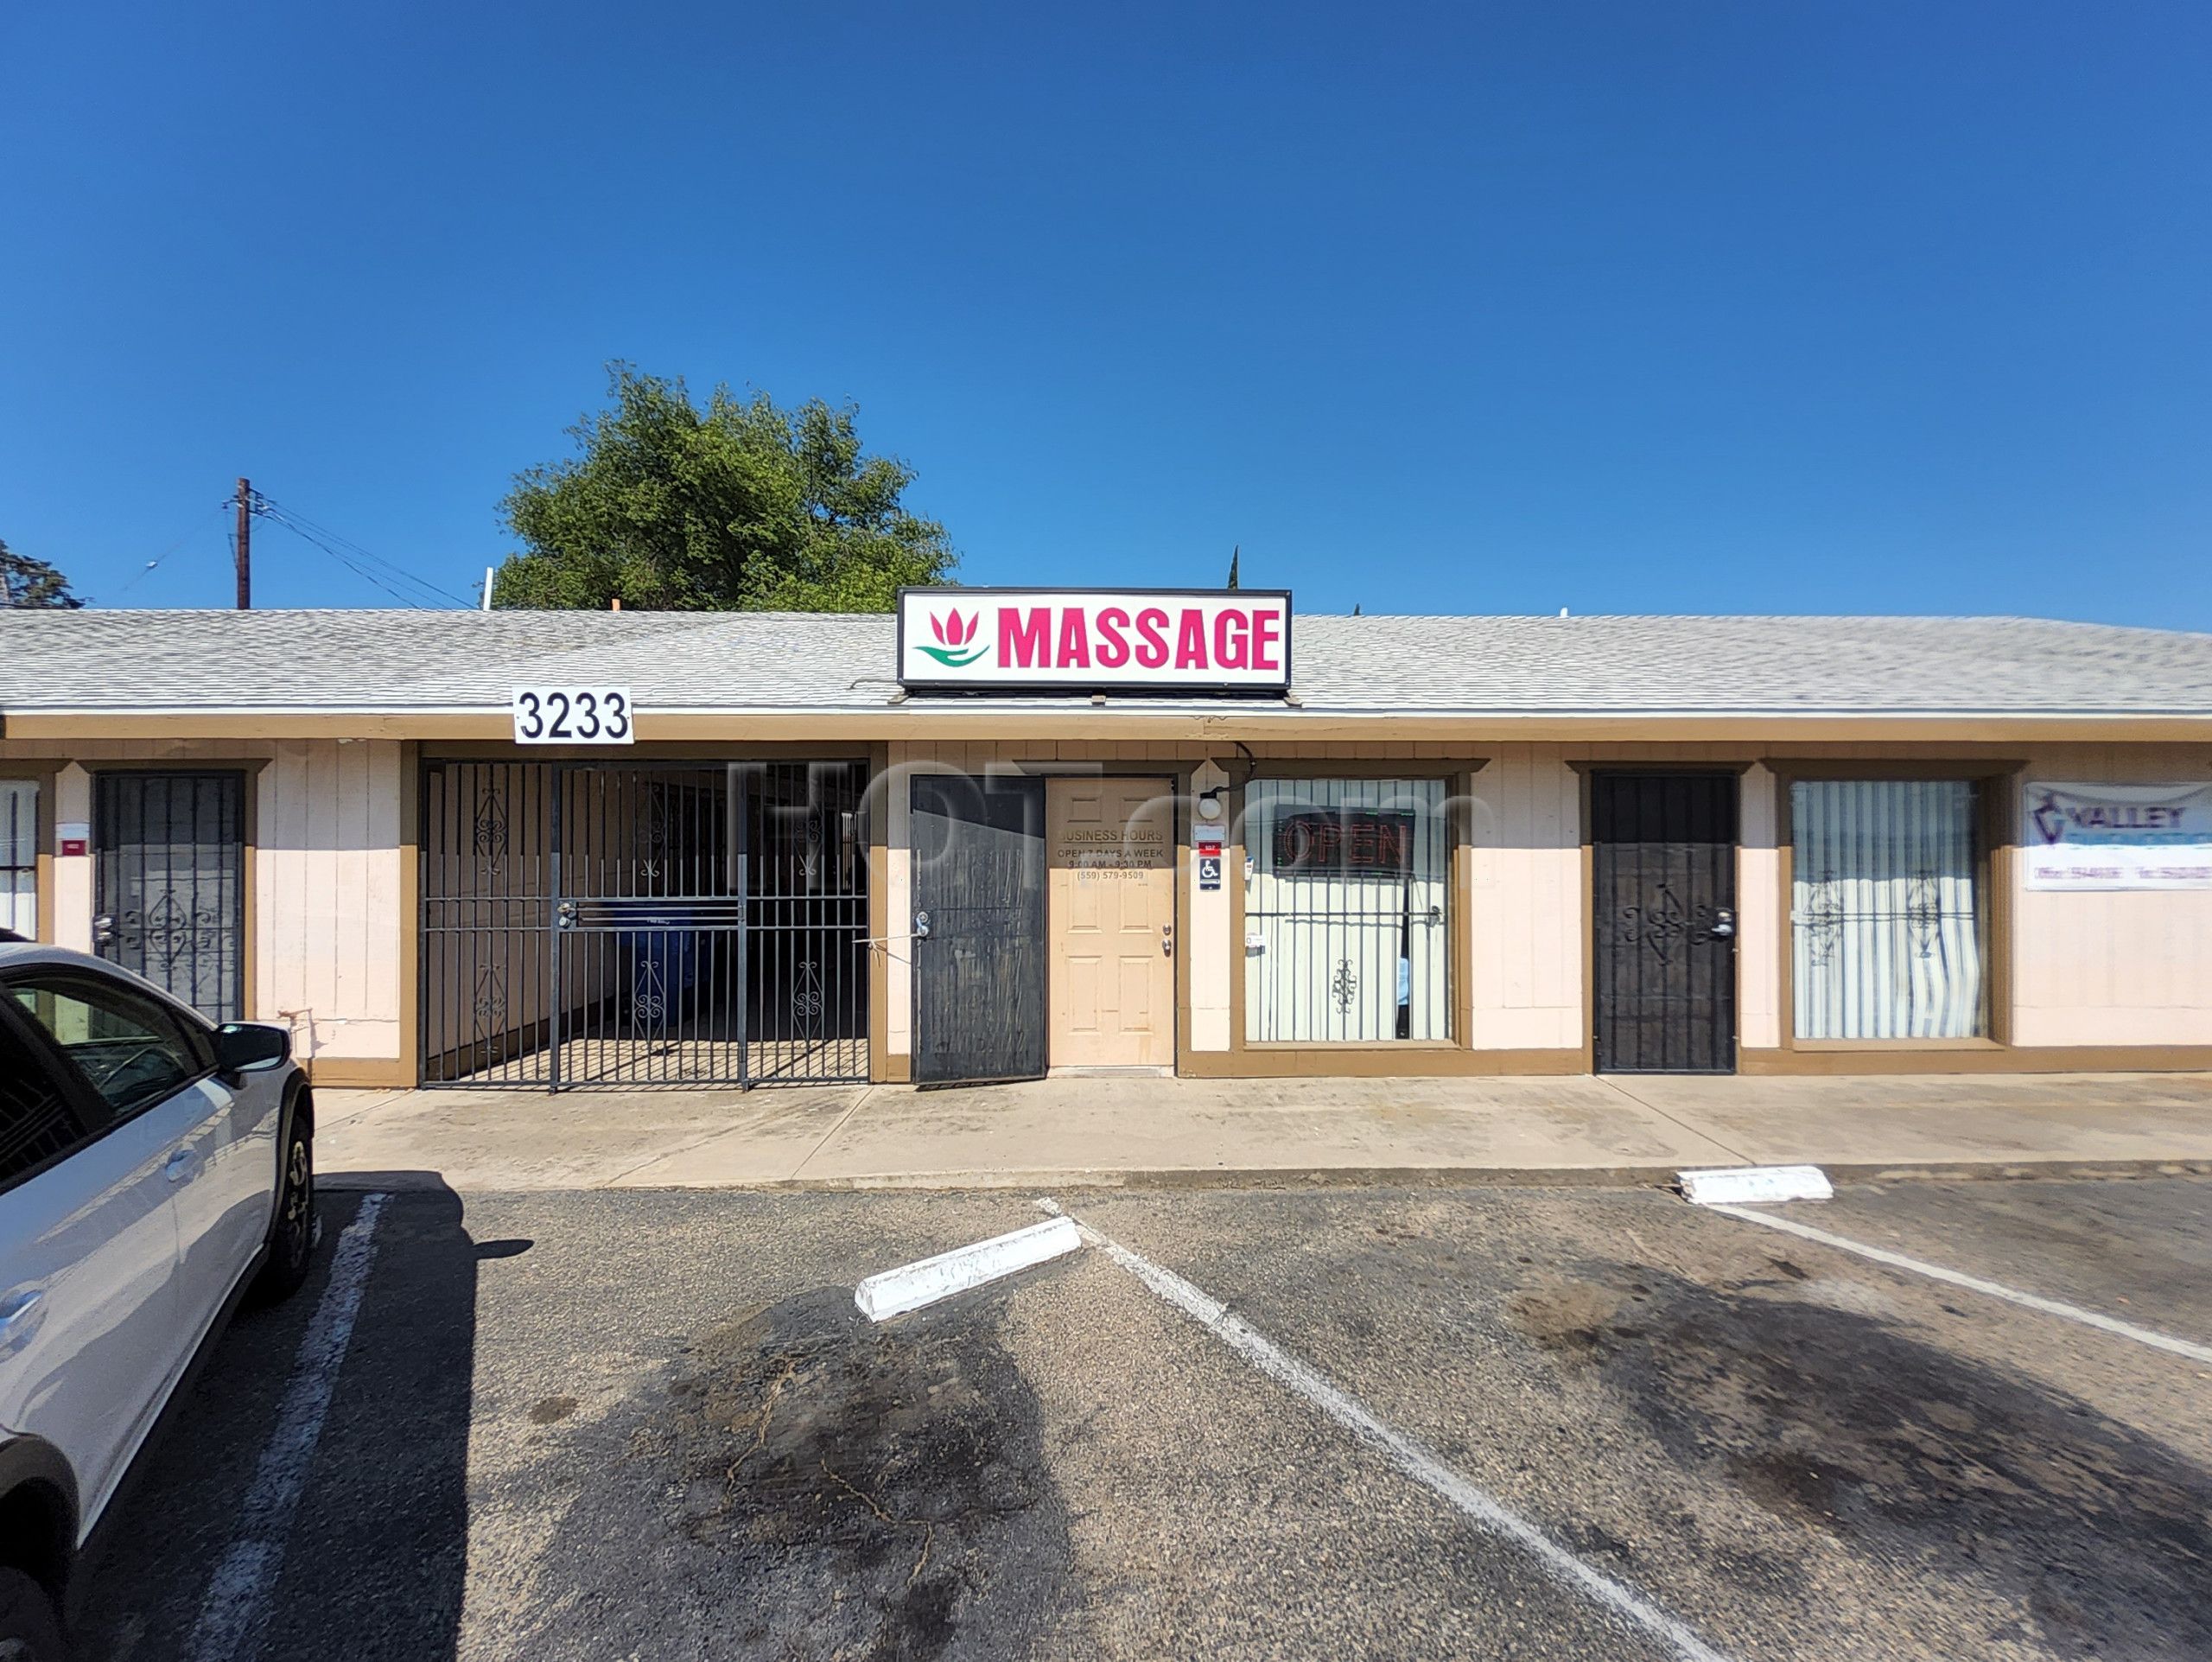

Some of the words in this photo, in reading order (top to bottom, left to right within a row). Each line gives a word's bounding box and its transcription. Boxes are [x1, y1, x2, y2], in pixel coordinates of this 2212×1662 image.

[997, 607, 1280, 671] MASSAGE
[518, 691, 628, 739] 3233
[2065, 806, 2188, 828] VALLEY
[1122, 830, 1163, 841] HOURS
[1283, 821, 1407, 864] OPEN
[1058, 849, 1085, 858] OPEN
[1096, 849, 1122, 858] DAYS
[1134, 849, 1163, 858] WEEK
[1092, 860, 1106, 869] AM
[1137, 860, 1152, 869] PM
[1077, 871, 1100, 881] (559)
